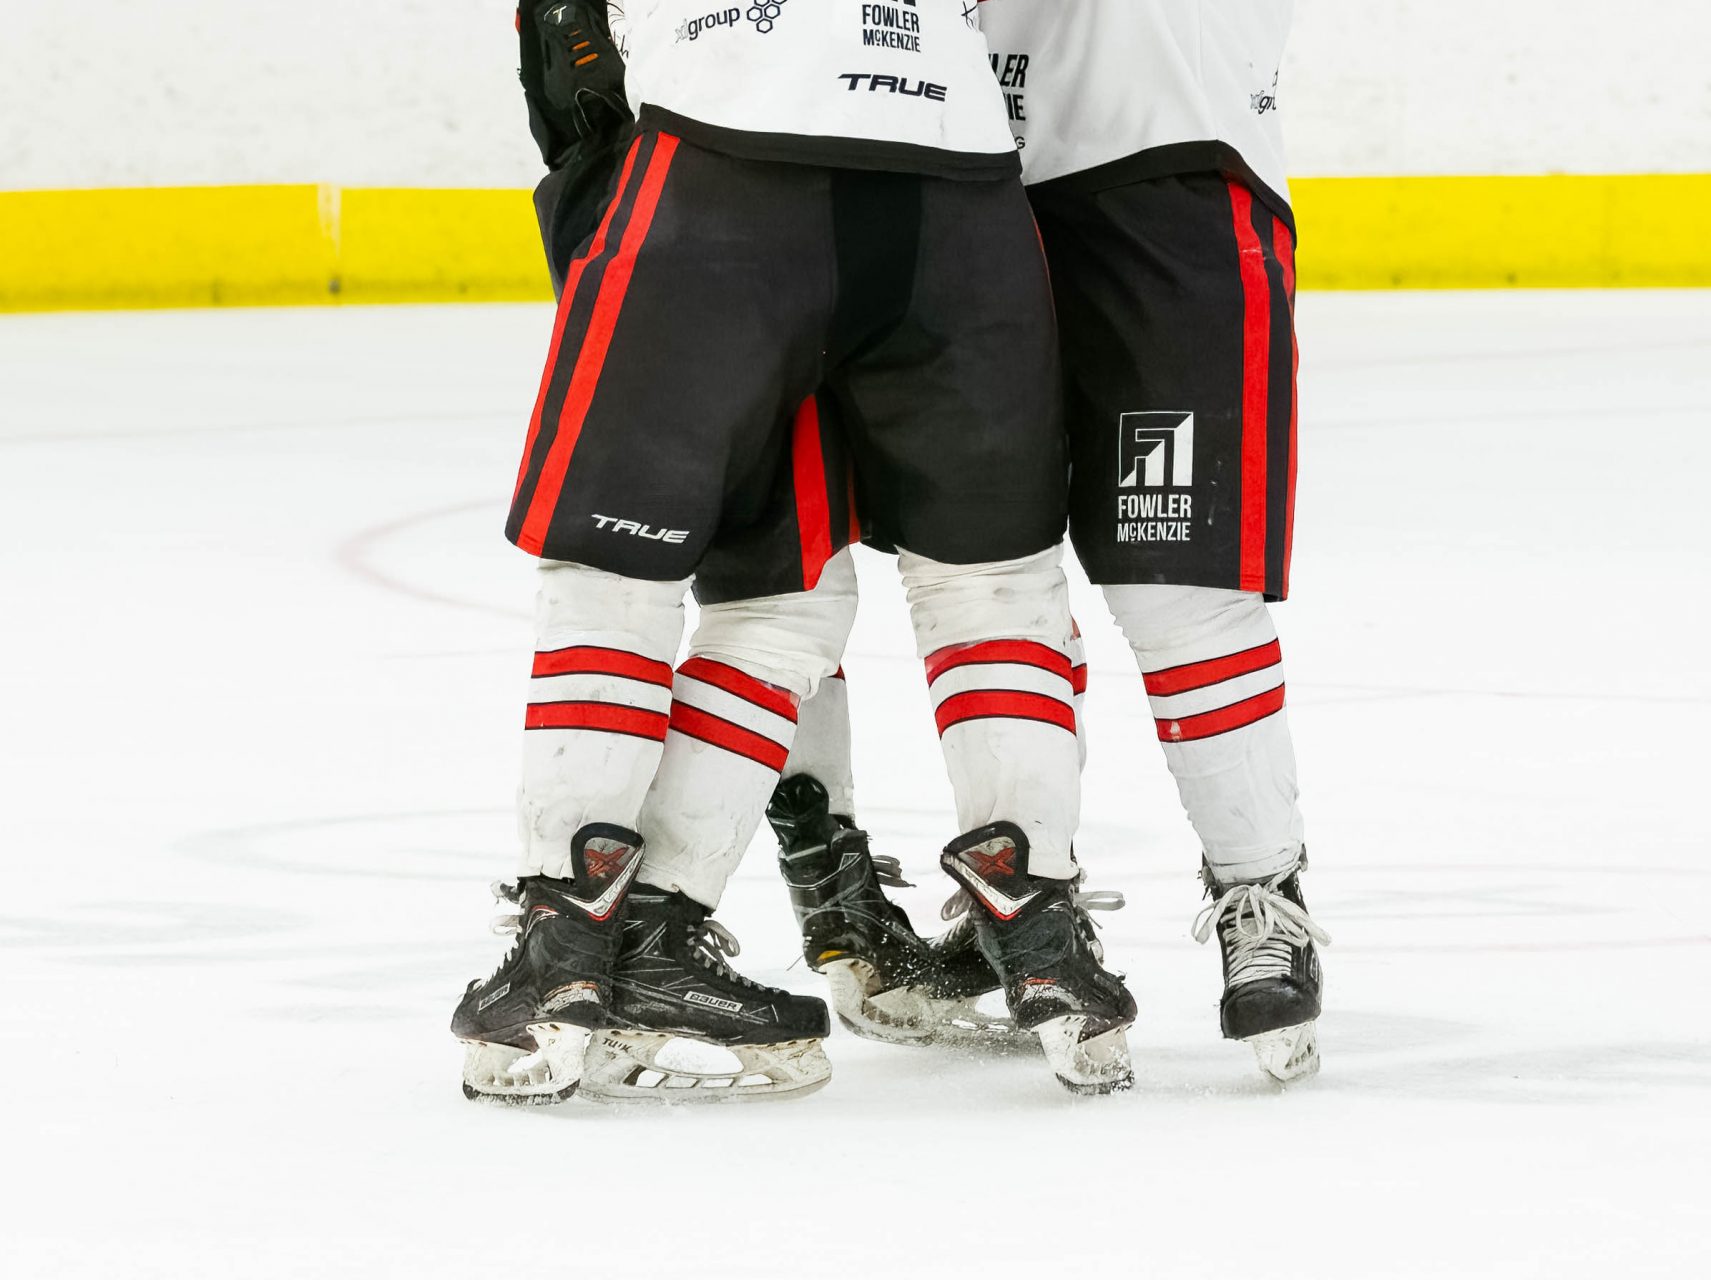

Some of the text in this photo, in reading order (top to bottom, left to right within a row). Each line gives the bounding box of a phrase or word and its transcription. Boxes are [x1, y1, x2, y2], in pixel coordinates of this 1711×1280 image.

[862, 4, 920, 33] FOWLER
[837, 73, 948, 102] TRUE
[1117, 494, 1192, 519] FOWLER
[591, 514, 690, 543] TRUE
[689, 993, 738, 1011] BAUER
